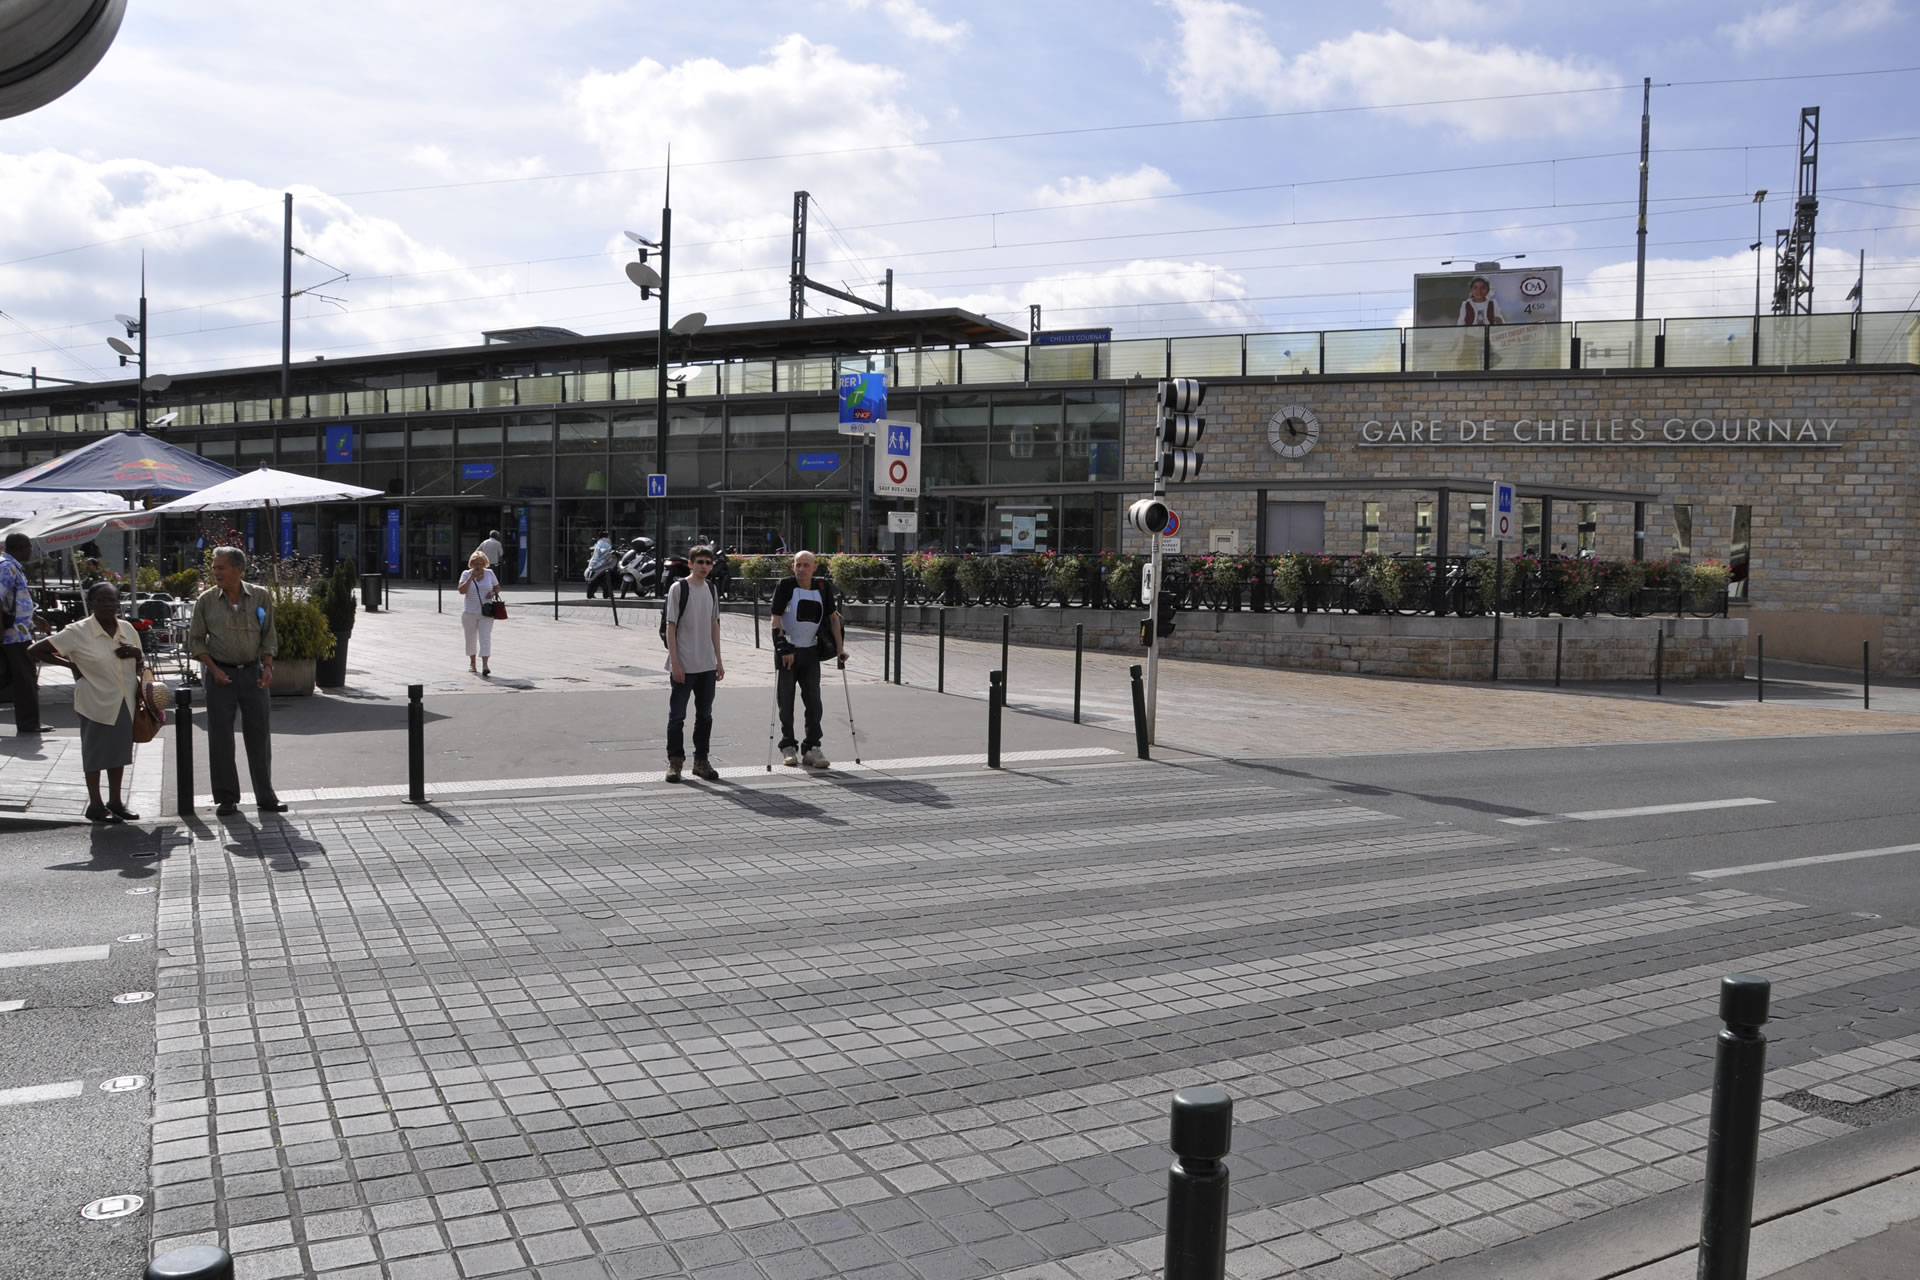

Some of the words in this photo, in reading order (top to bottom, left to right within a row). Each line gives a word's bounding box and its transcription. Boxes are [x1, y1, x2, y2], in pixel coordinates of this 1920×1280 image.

[1525, 282, 1543, 292] C&A
[839, 376, 857, 388] RER
[1362, 420, 1443, 442] GARE
[1460, 419, 1496, 441] DE
[1513, 419, 1645, 441] CHELLES
[1663, 418, 1838, 441] GOURNAY
[113, 471, 152, 481] Red
[156, 471, 192, 483] Bull
